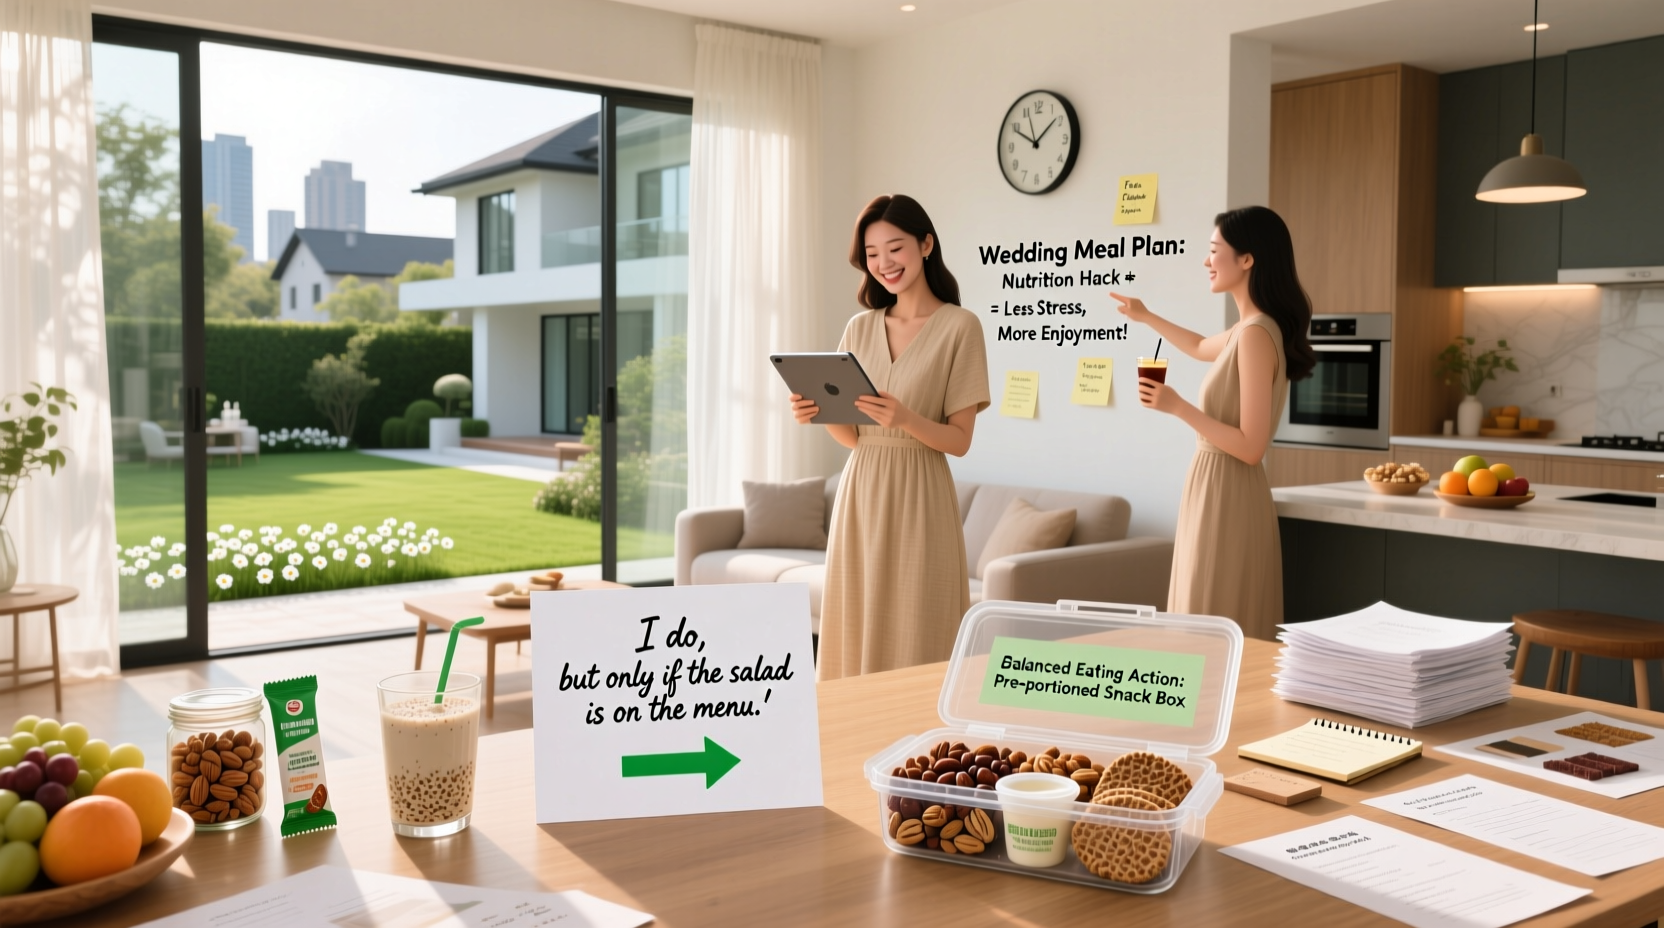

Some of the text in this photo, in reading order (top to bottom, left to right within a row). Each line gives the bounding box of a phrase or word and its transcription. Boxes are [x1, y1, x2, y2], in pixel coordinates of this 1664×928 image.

[979, 235, 1185, 267] Wedding Meal Plan:
[1002, 272, 1073, 289] Nutrition
[1080, 269, 1120, 285] Hack
[991, 300, 1086, 317] = Less Stress,
[998, 324, 1128, 346] More Enjoyment!
[635, 616, 705, 653] I do,
[559, 653, 794, 698] but only if the salad
[1001, 655, 1184, 687] Balanced Eating Action:
[994, 674, 1186, 708] Pre-portioned Snack Box
[586, 702, 604, 725] is
[613, 705, 641, 723] on
[649, 694, 687, 721] the
